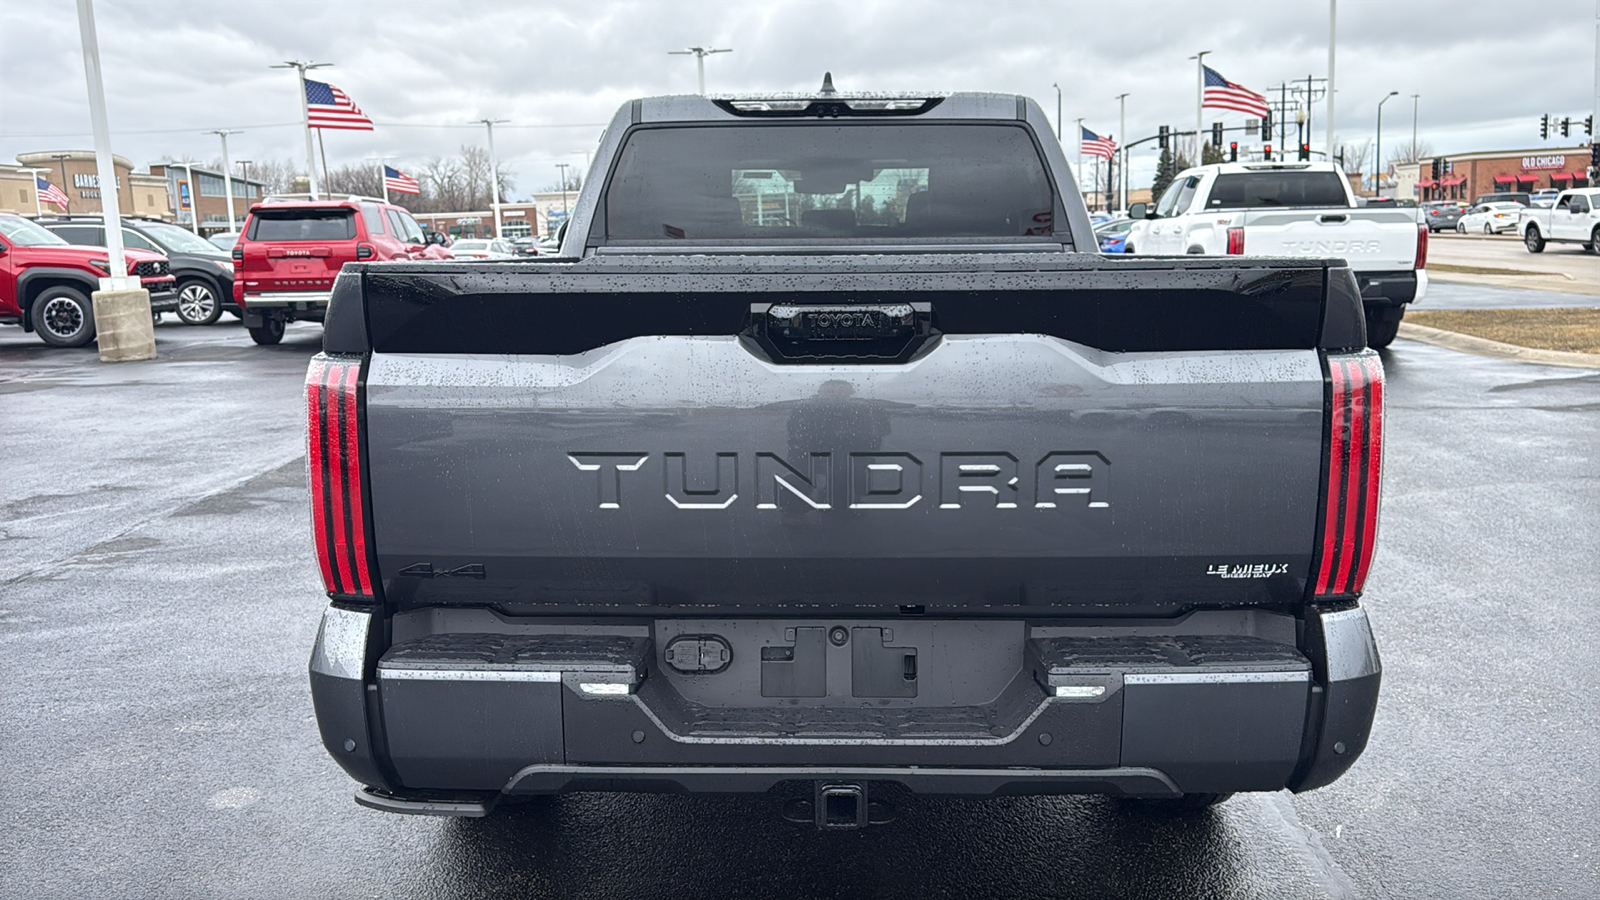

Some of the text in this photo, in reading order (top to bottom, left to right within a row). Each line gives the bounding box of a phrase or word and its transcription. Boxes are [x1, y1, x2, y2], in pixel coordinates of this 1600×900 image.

[1522, 157, 1535, 168] OLD
[1536, 155, 1565, 167] CHICAGO
[1282, 240, 1381, 255] TUNDRA
[807, 312, 874, 328] TOYOTA
[567, 451, 1112, 510] TUNDRA
[1206, 563, 1289, 574] LE MIEUX
